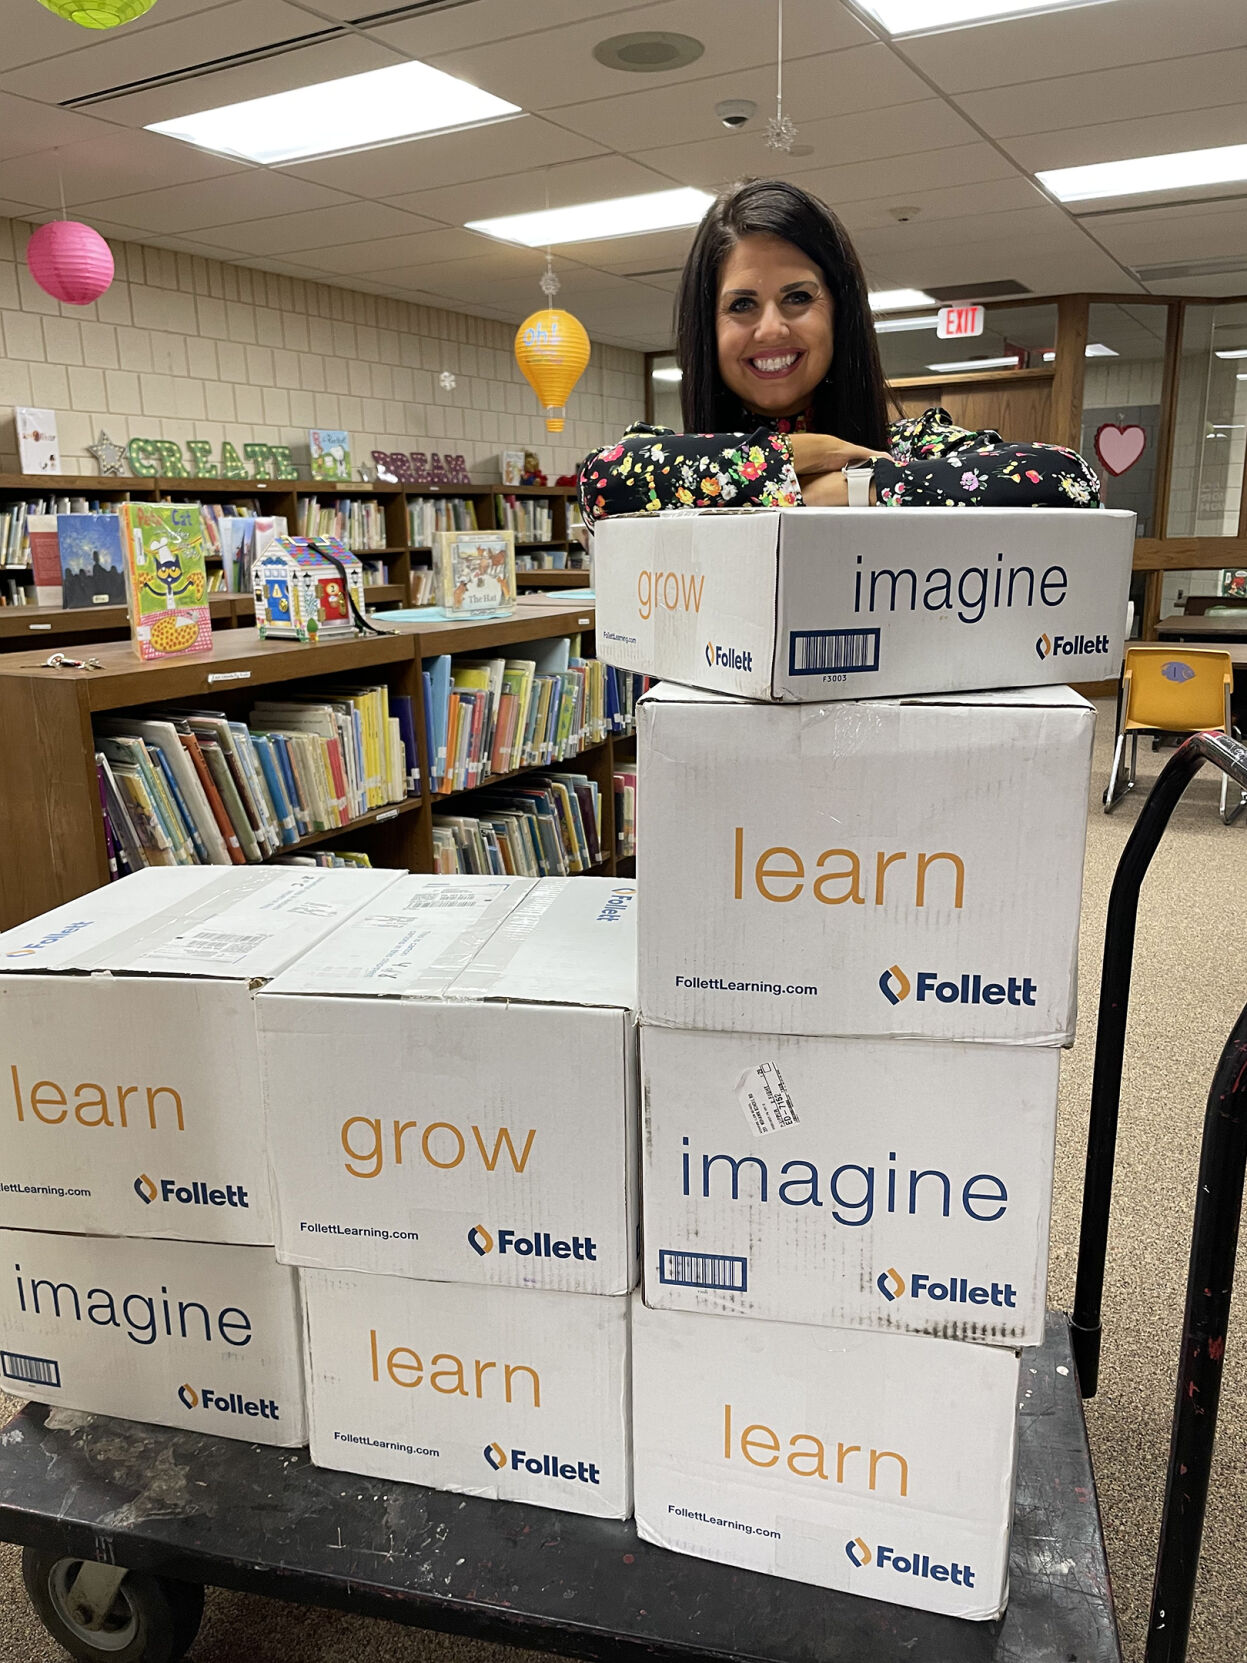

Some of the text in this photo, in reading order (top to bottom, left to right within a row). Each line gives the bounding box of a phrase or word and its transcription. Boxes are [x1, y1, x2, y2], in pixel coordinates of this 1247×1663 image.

[946, 307, 978, 335] EXIT
[129, 438, 298, 480] CREATE
[371, 451, 470, 484] DREAM
[172, 508, 193, 526] Cat
[638, 570, 704, 620] grow
[854, 553, 1068, 624] imagine
[603, 631, 637, 644] FollettLearning.com
[1052, 634, 1109, 656] Follett
[715, 645, 753, 672] Follett
[822, 674, 847, 683] F3003
[734, 827, 965, 909] learn
[596, 895, 633, 921] Follett
[22, 921, 95, 948] Follett
[675, 976, 818, 996] FollettLearning.com
[916, 972, 1037, 1007] Follett
[11, 1065, 185, 1131] learn
[341, 1116, 536, 1178] grow
[161, 1180, 249, 1208] Follett
[682, 1137, 1008, 1227] imagine
[300, 1222, 418, 1241] FollettLearning.com
[498, 1230, 597, 1261] Follett
[15, 1264, 252, 1345] imagine
[911, 1274, 1016, 1308] Follett
[370, 1330, 541, 1407] learn
[201, 1390, 279, 1420] Follett
[333, 1432, 440, 1457] FollettLearning.com
[723, 1404, 908, 1497] learn
[511, 1455, 600, 1484] Follett
[667, 1505, 781, 1540] FollettLearning.com
[876, 1546, 975, 1589] Follett
